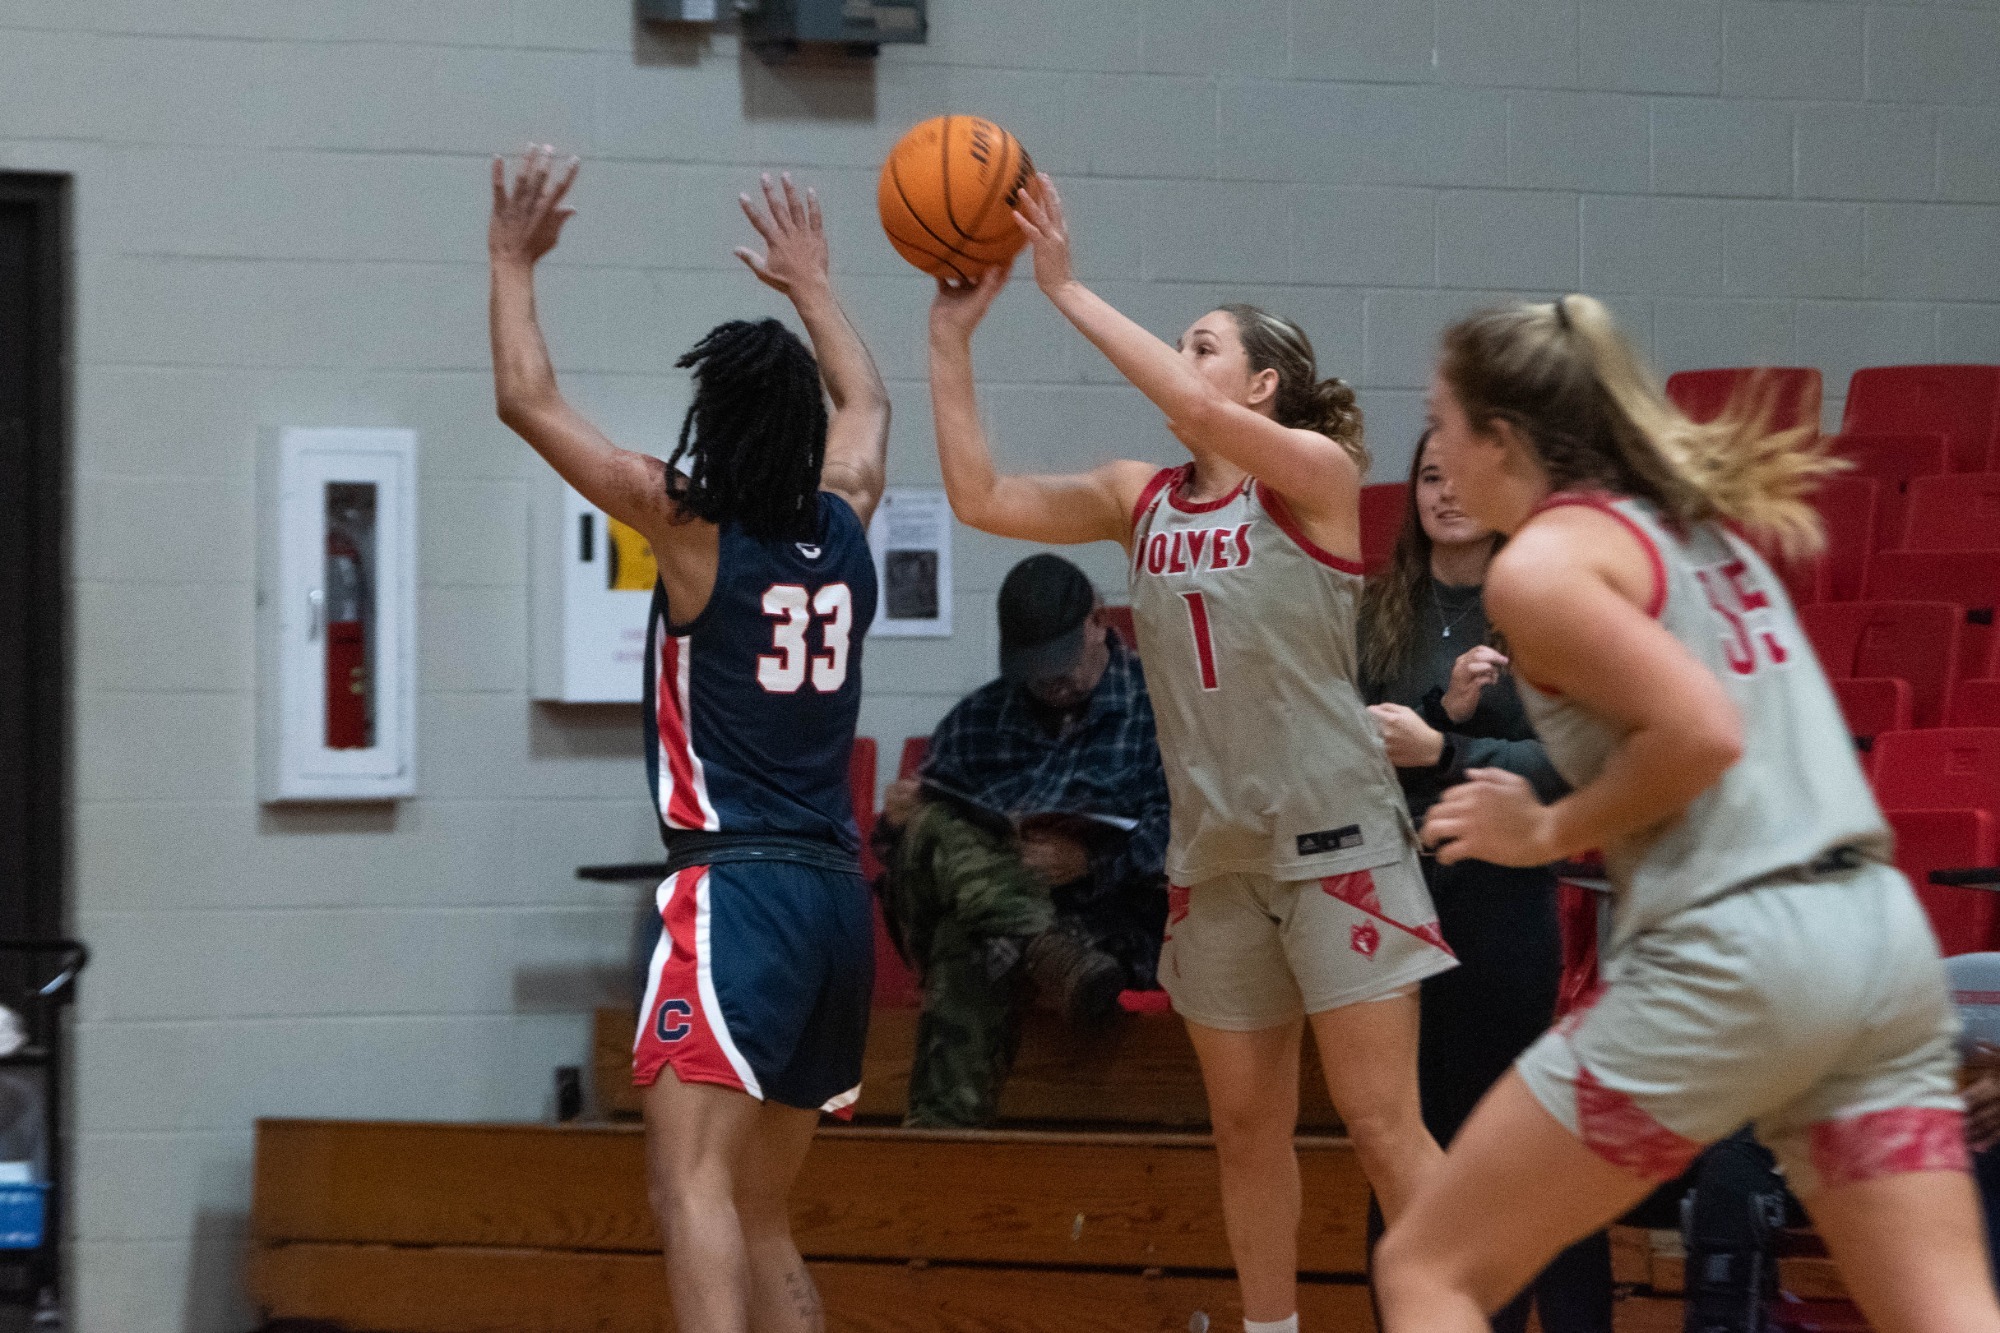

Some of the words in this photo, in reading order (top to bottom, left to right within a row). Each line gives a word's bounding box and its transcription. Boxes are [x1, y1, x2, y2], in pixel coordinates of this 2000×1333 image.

[757, 580, 853, 694] 33
[1177, 589, 1219, 692] 1
[655, 998, 693, 1043] C
